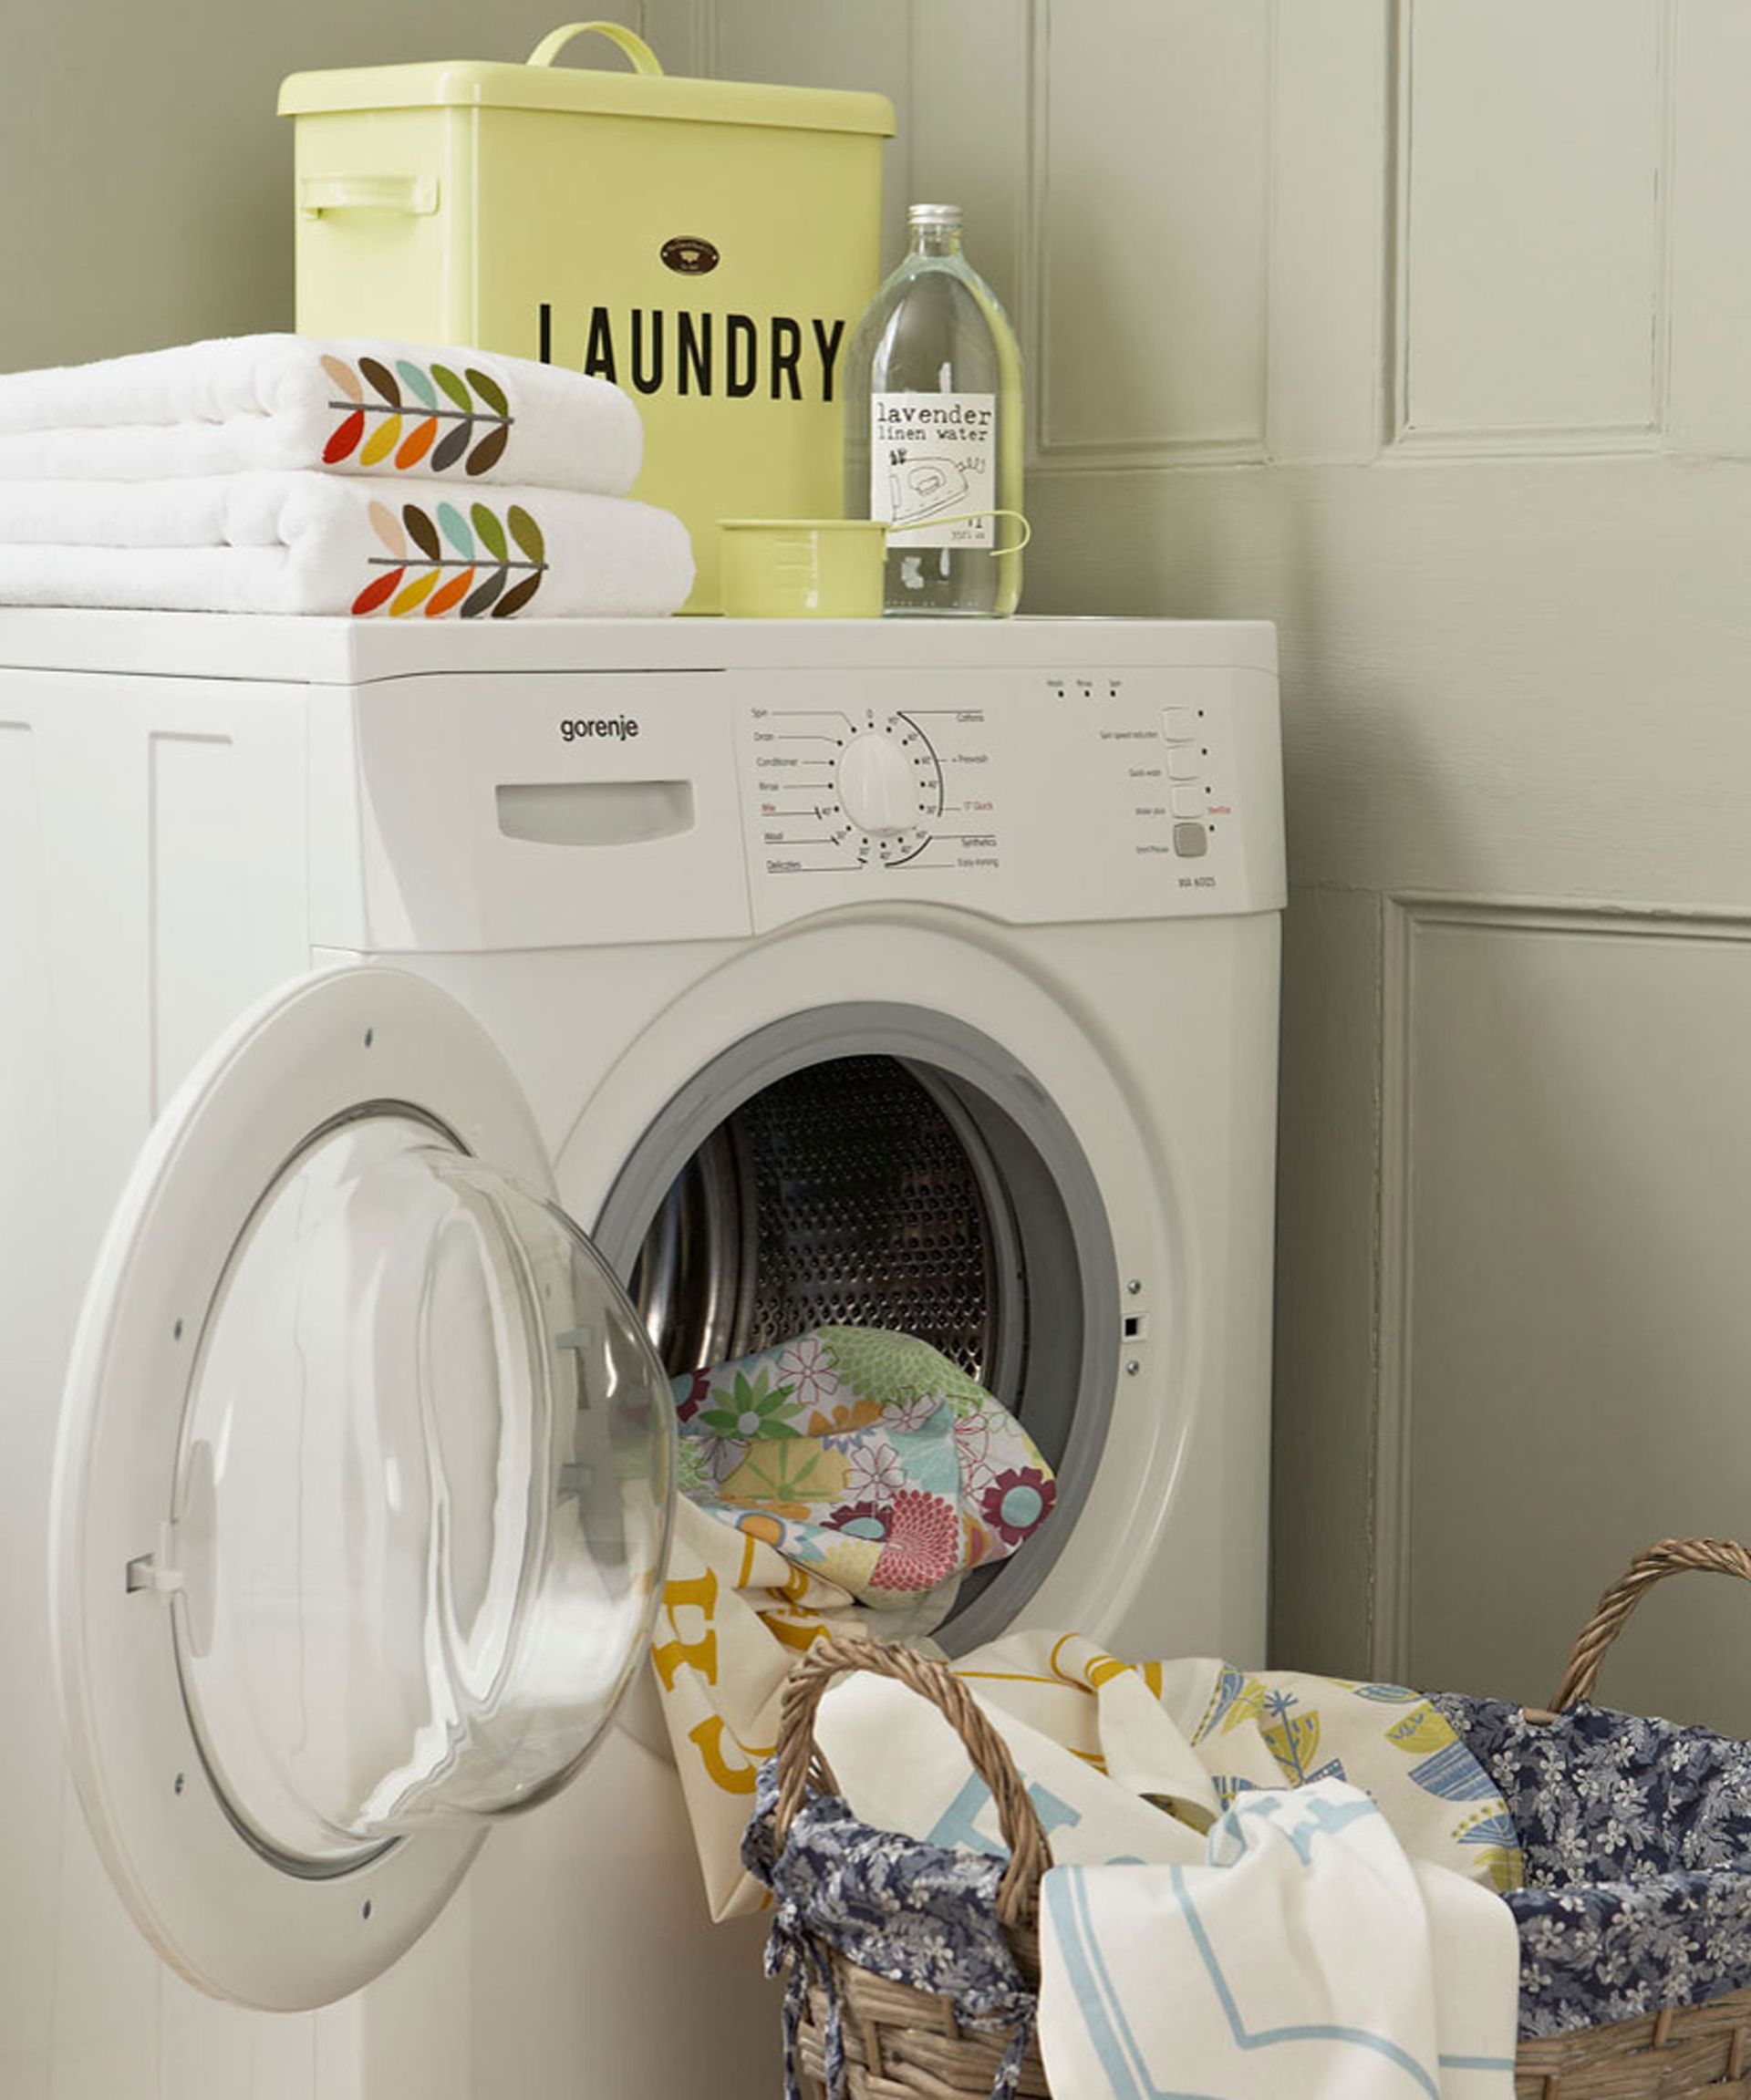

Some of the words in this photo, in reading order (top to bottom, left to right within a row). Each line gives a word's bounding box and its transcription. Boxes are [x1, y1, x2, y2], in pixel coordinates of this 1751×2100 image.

[538, 303, 845, 401] LAUNDRY
[876, 401, 992, 426] lavender
[878, 426, 927, 440] linen
[937, 428, 989, 441] water
[560, 714, 639, 741] gorenje
[756, 758, 798, 767] Conditioner
[960, 838, 998, 848] Synthetics
